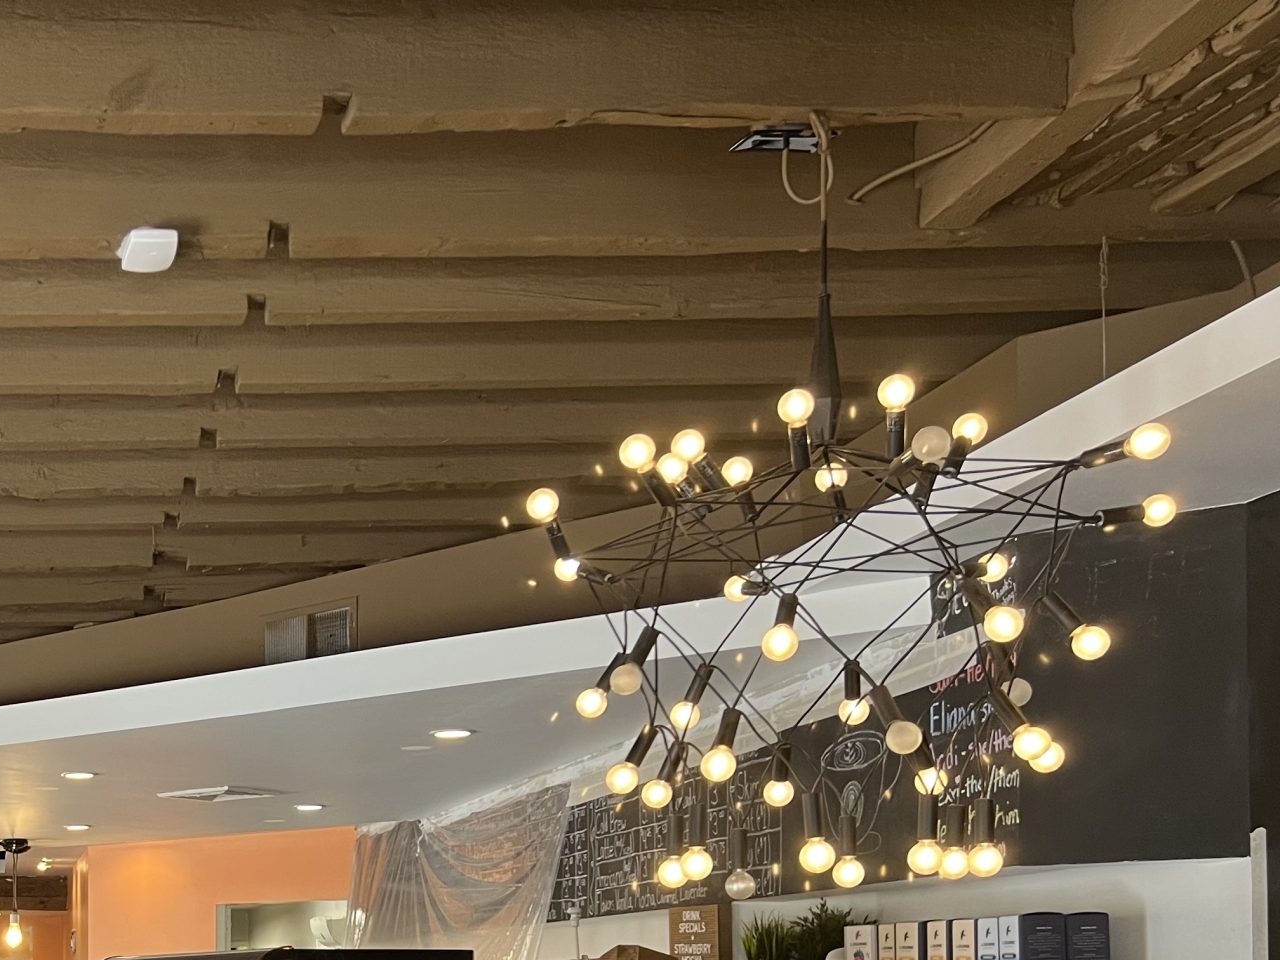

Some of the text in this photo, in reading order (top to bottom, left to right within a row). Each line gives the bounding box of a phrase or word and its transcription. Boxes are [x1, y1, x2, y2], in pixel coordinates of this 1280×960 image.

[595, 811, 608, 834] Cold
[682, 910, 701, 921] DRINK
[678, 922, 706, 933] SPECIALS
[674, 943, 712, 954] STRAWBERRY
